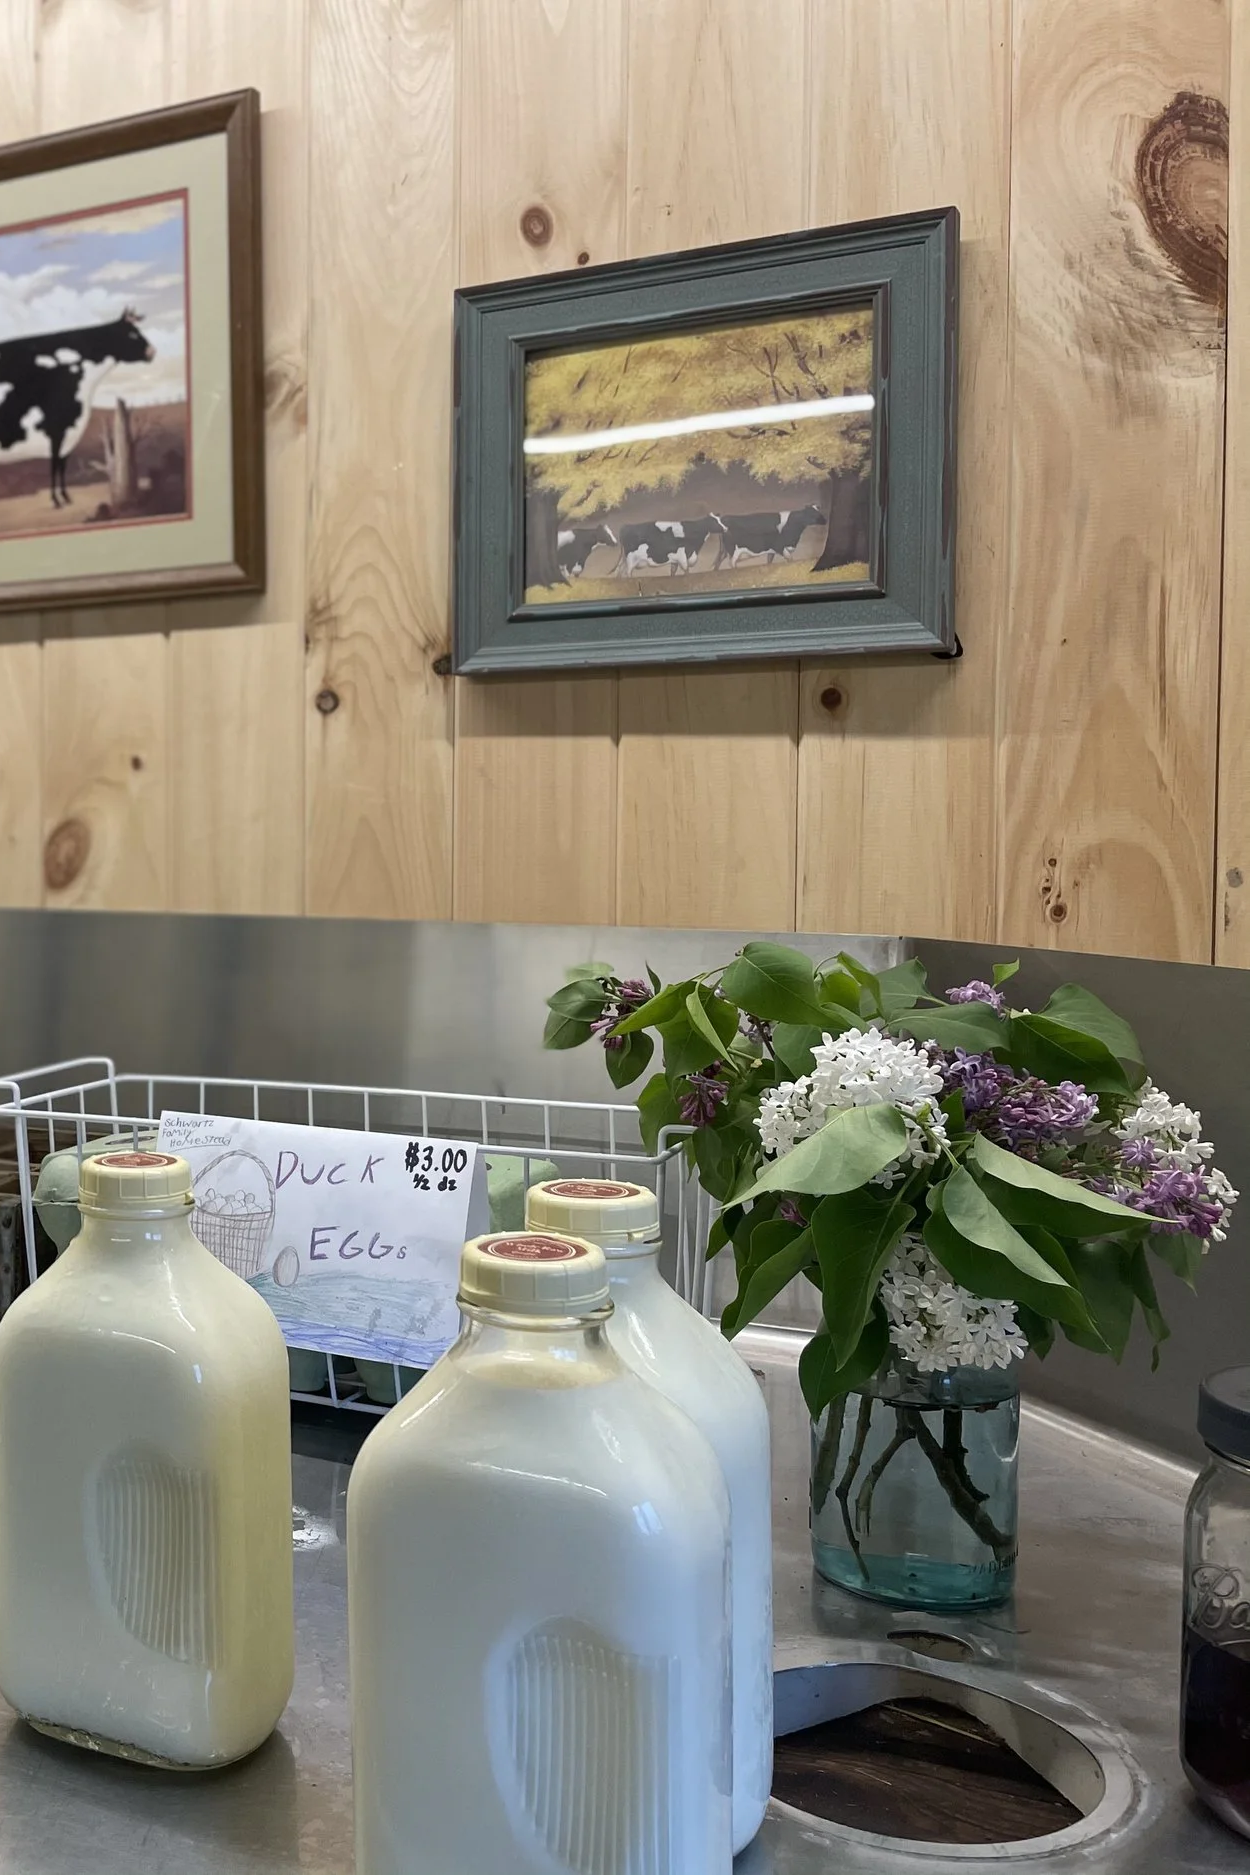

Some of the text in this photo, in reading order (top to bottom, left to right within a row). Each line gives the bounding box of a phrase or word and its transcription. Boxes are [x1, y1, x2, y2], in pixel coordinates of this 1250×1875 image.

[164, 1117, 215, 1128] Schwartz
[405, 1141, 468, 1173] $3.00
[275, 1150, 385, 1190] DUCK
[437, 1175, 458, 1192] dz
